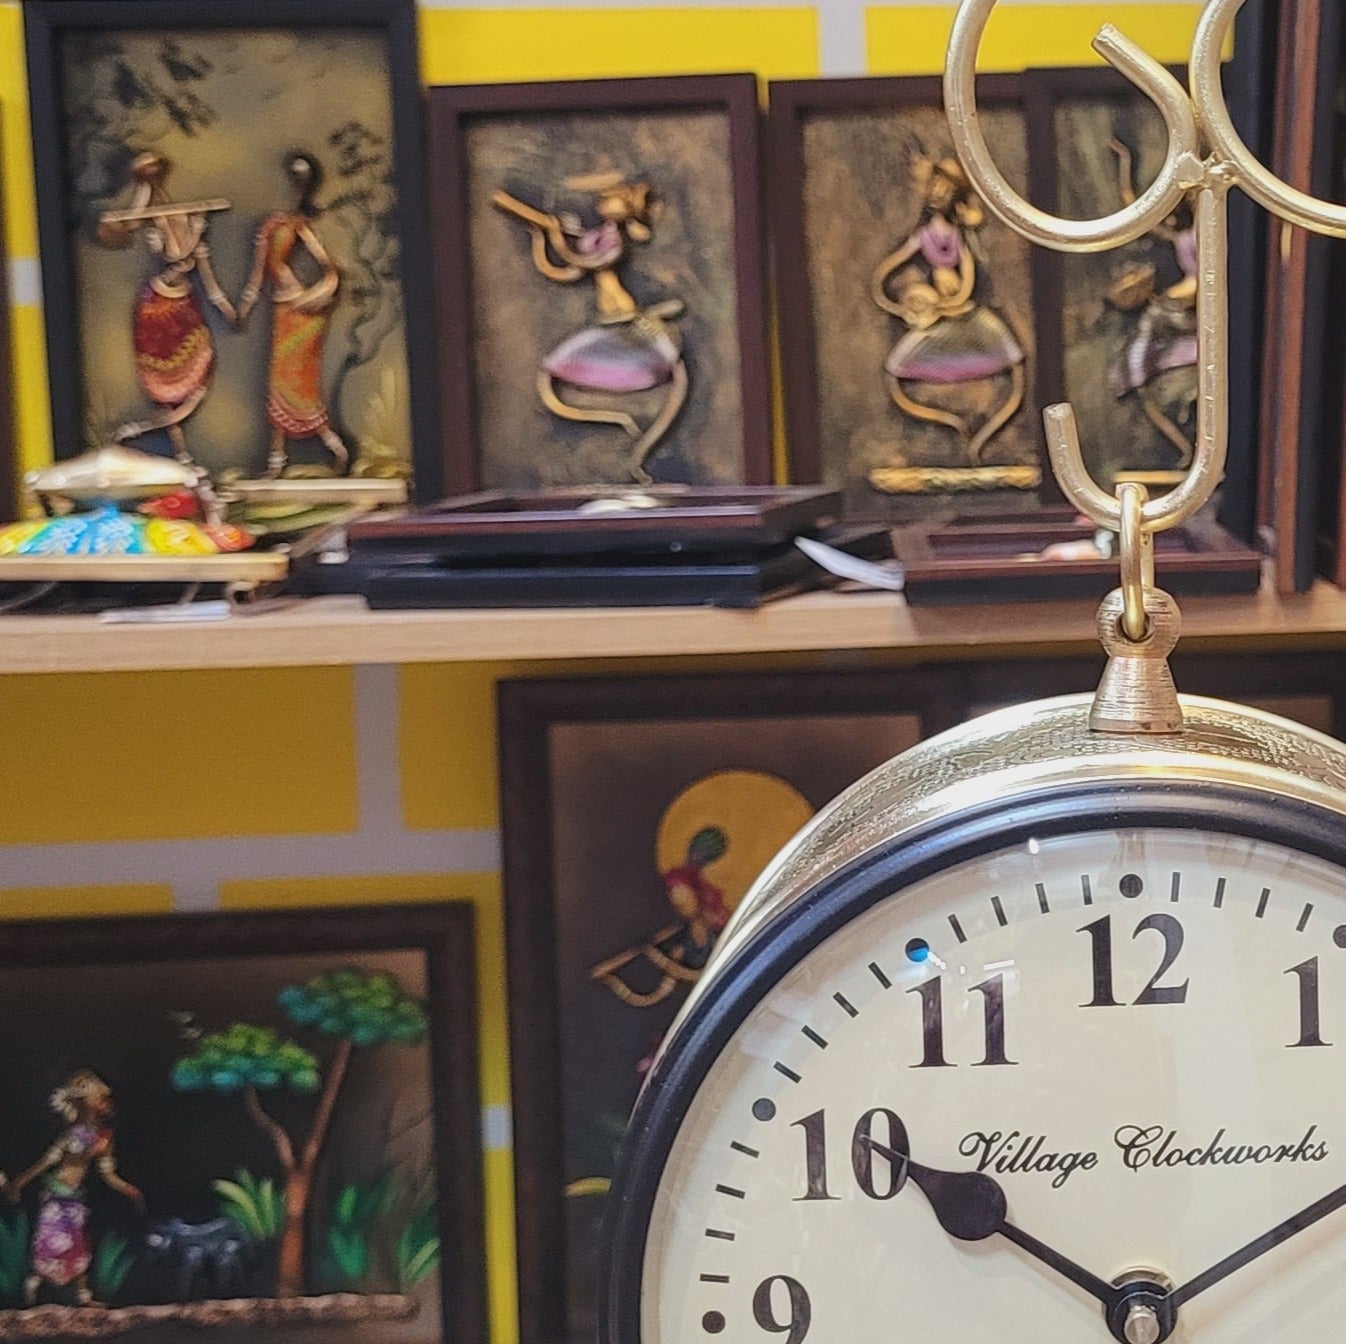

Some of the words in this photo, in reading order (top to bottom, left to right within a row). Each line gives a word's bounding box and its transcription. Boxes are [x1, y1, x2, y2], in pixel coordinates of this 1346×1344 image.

[1076, 914, 1189, 1007] 12
[1284, 956, 1333, 1047] 1
[906, 975, 1019, 1068] 11
[789, 1107, 910, 1201] 10
[958, 1130, 1098, 1188] Village
[1114, 1125, 1328, 1172] Clockworks
